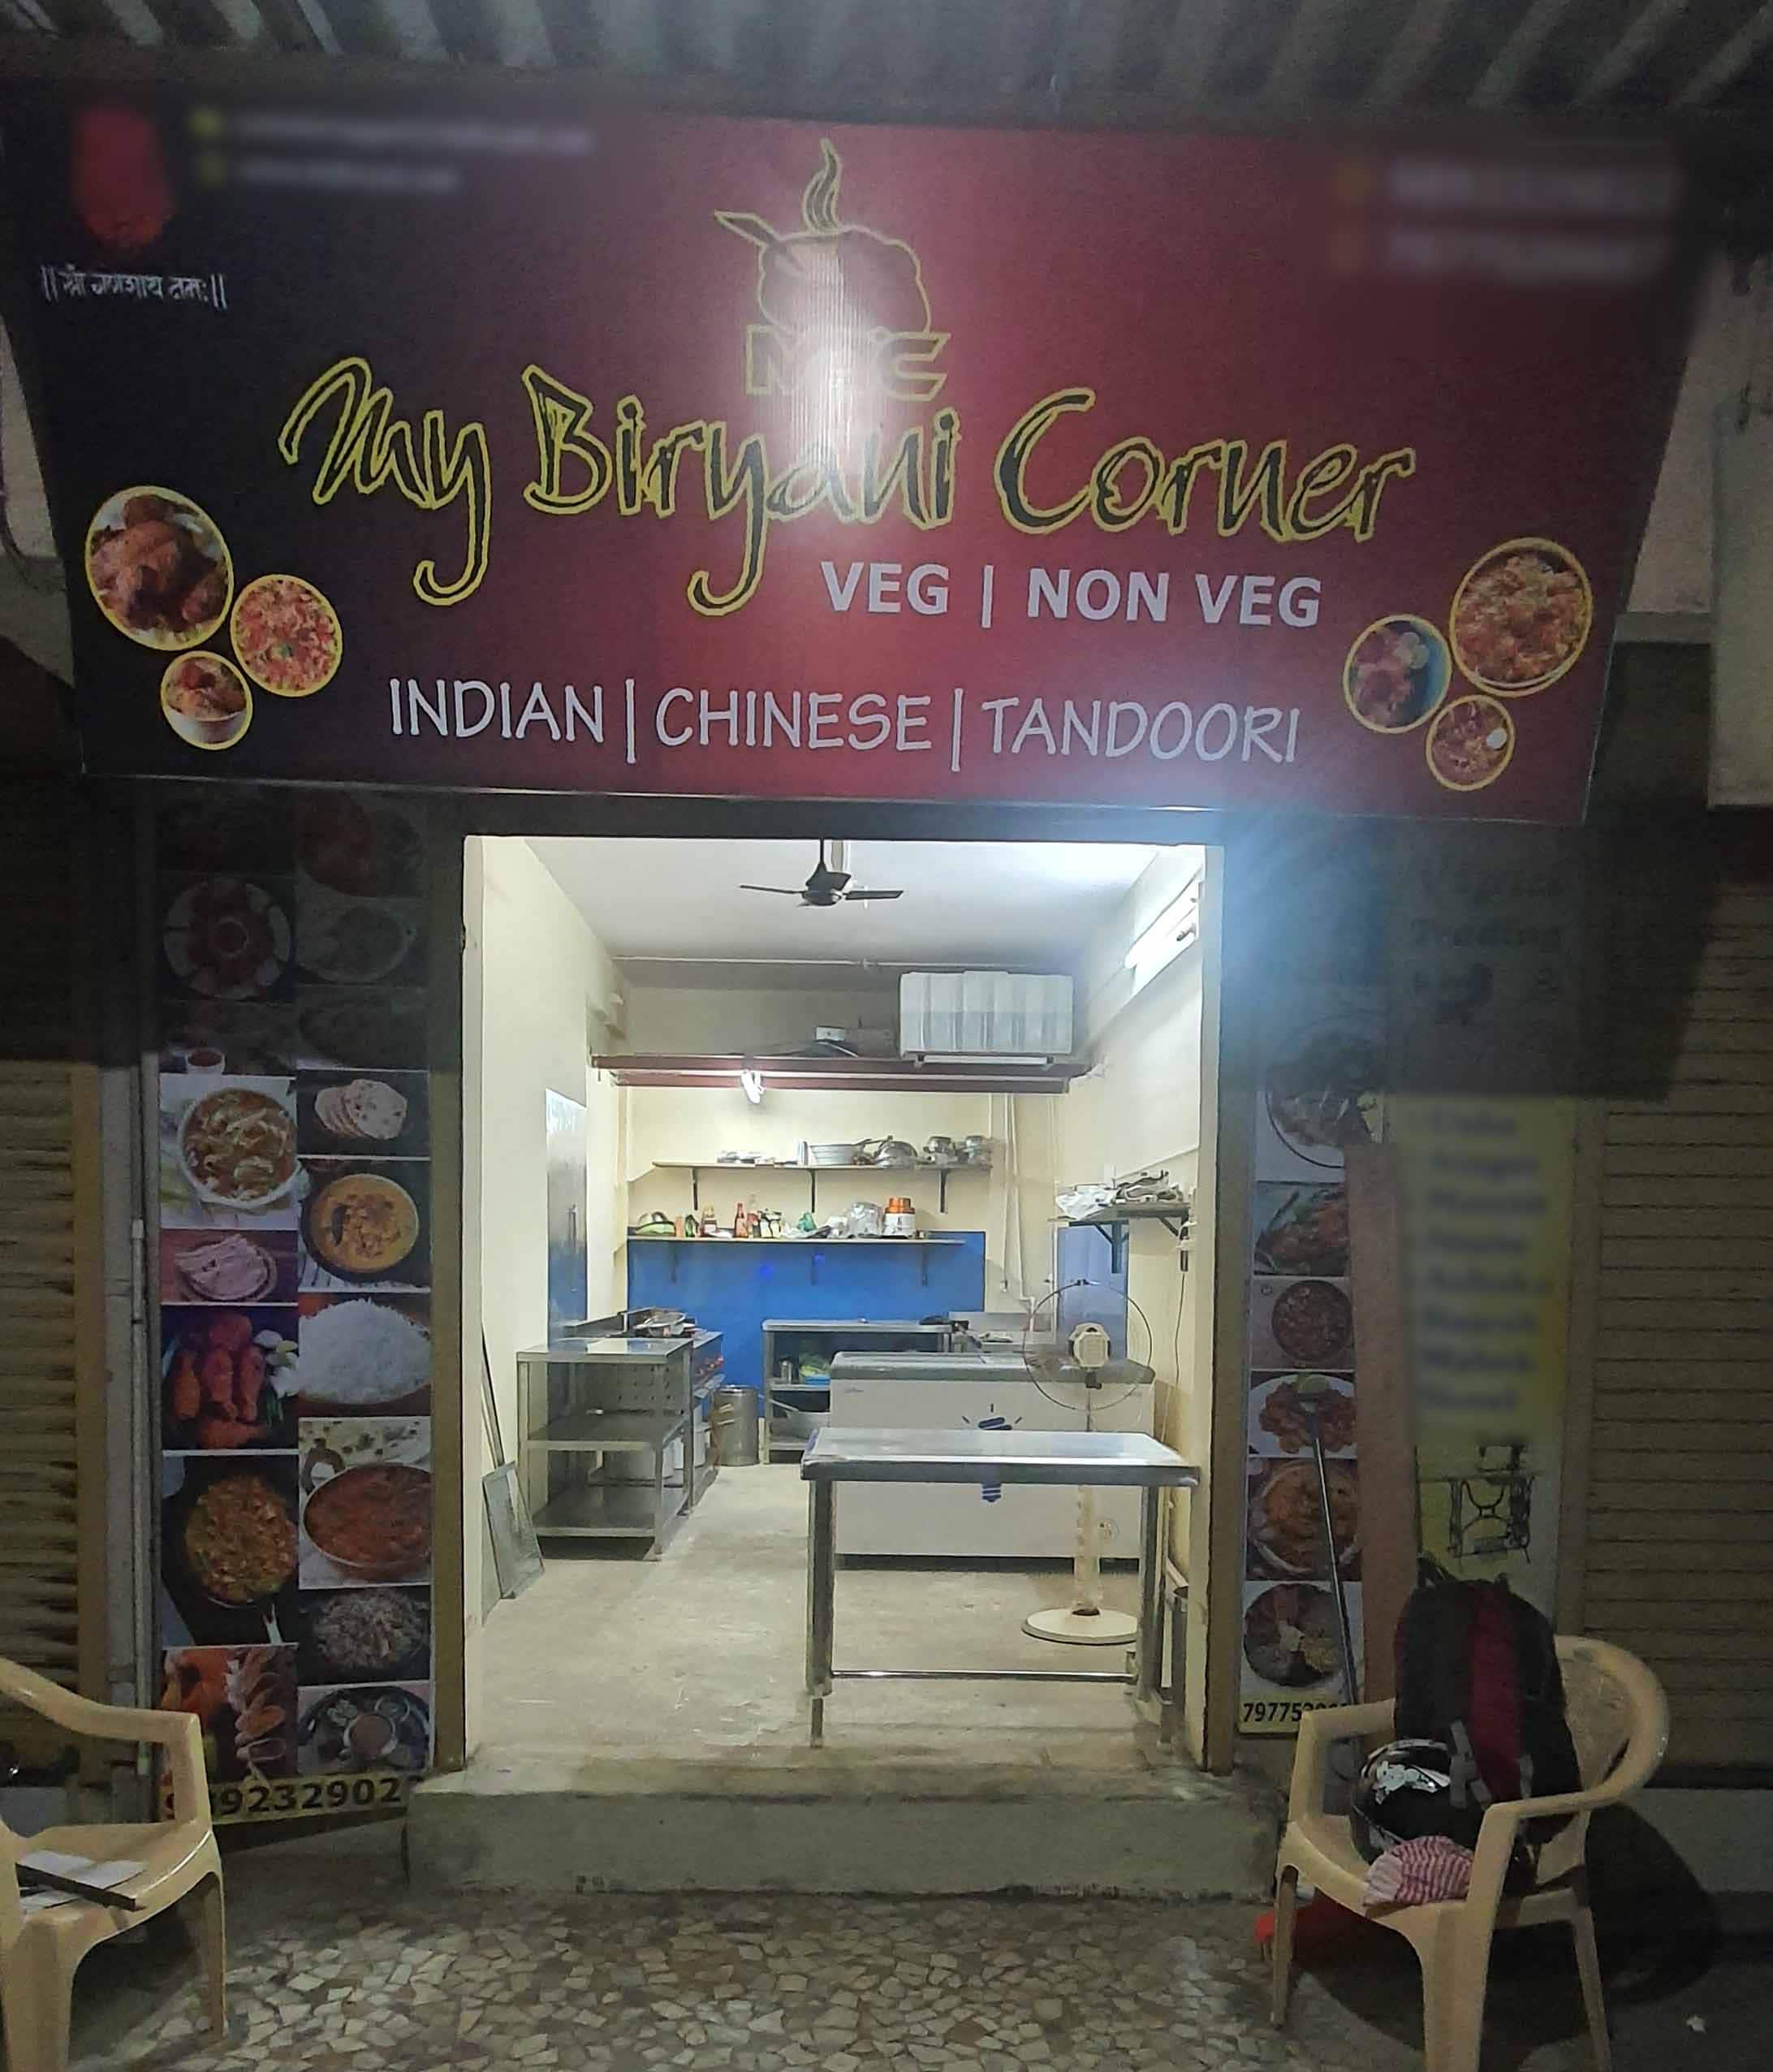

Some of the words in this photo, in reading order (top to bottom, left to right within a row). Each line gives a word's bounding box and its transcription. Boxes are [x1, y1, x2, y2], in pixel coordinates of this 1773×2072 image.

[746, 324, 951, 402] MC
[278, 356, 492, 606] My
[522, 365, 961, 616] Biryani
[994, 387, 1416, 543] Corner
[821, 561, 949, 615] VEG
[1027, 568, 1170, 622] NON
[1194, 573, 1322, 628] VEG
[390, 678, 604, 743] INDIAN
[655, 687, 933, 750] CHINESE
[981, 697, 1301, 762] TANDOORI
